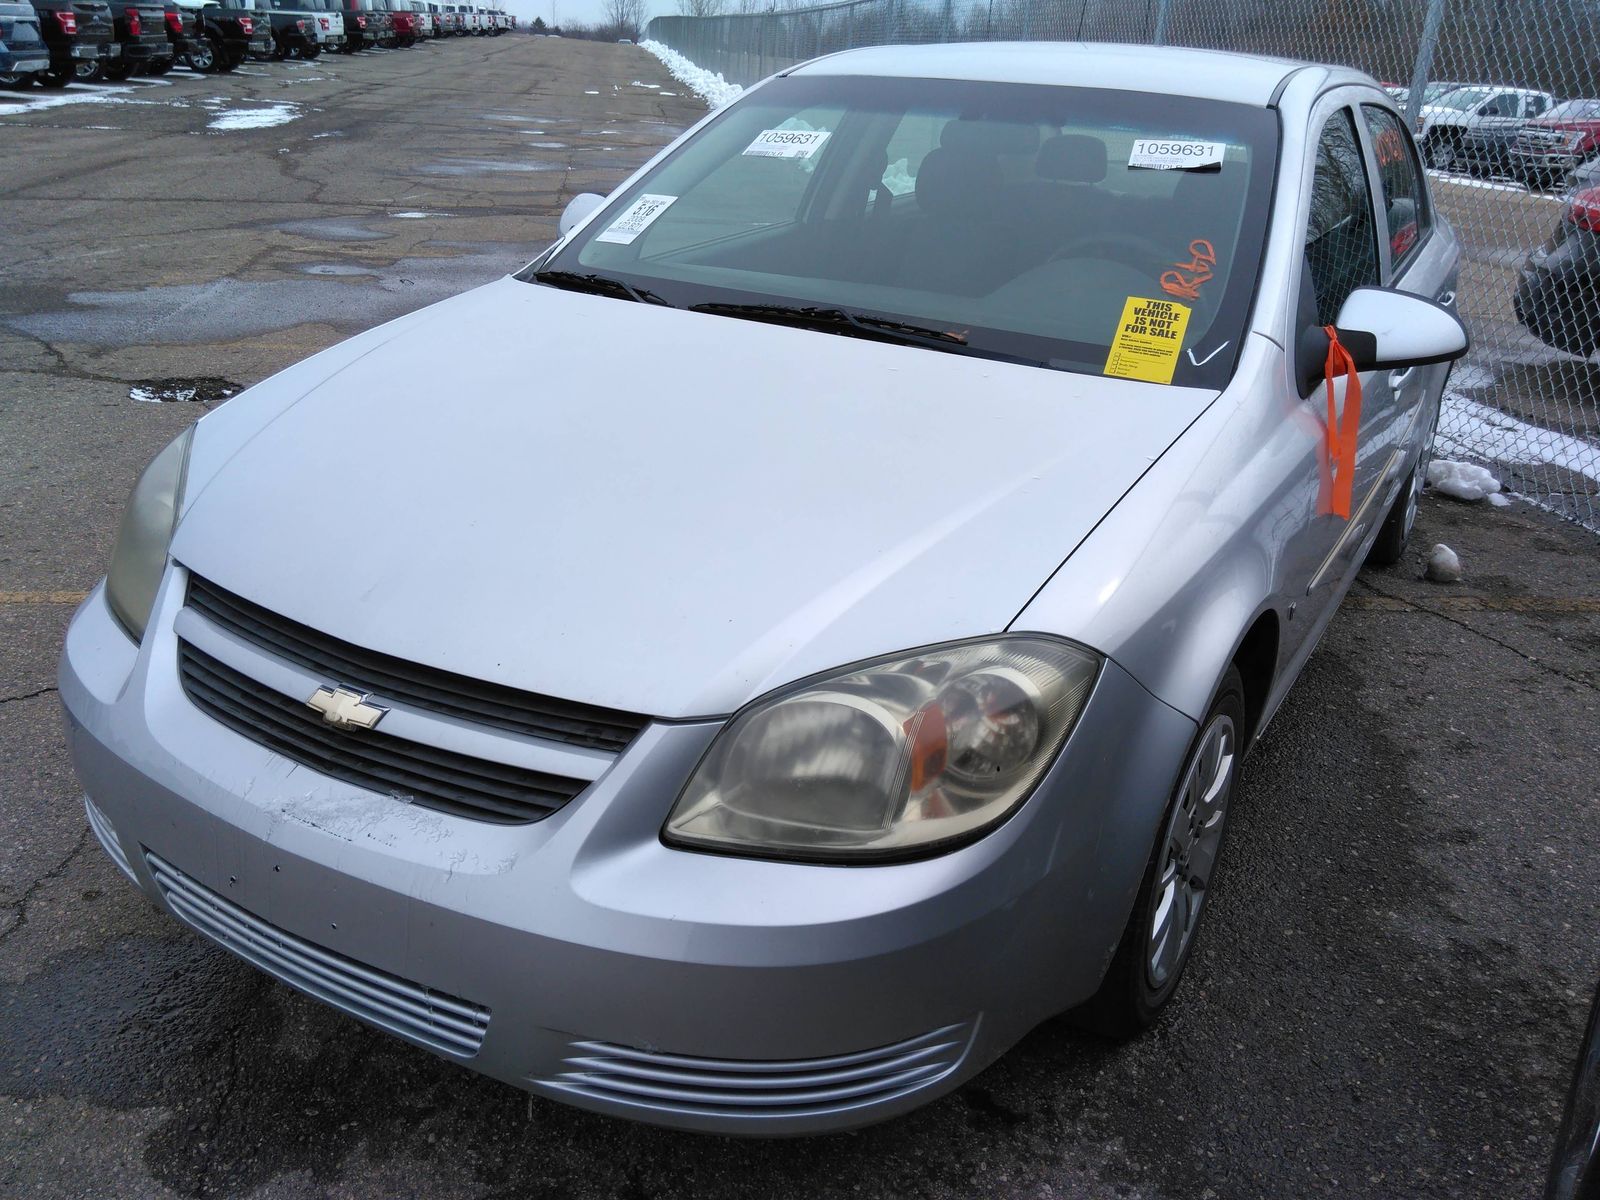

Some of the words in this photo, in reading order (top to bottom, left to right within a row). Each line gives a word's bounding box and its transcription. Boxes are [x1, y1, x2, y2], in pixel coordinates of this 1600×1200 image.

[759, 132, 820, 145] 1059631
[1138, 143, 1215, 157] 1059631
[1145, 300, 1173, 312] THIS
[1133, 307, 1181, 322] VEHICLE
[1134, 316, 1148, 326] IS
[1149, 319, 1174, 330] NOT
[1124, 323, 1148, 335] FOR
[1149, 327, 1178, 340] SALE
